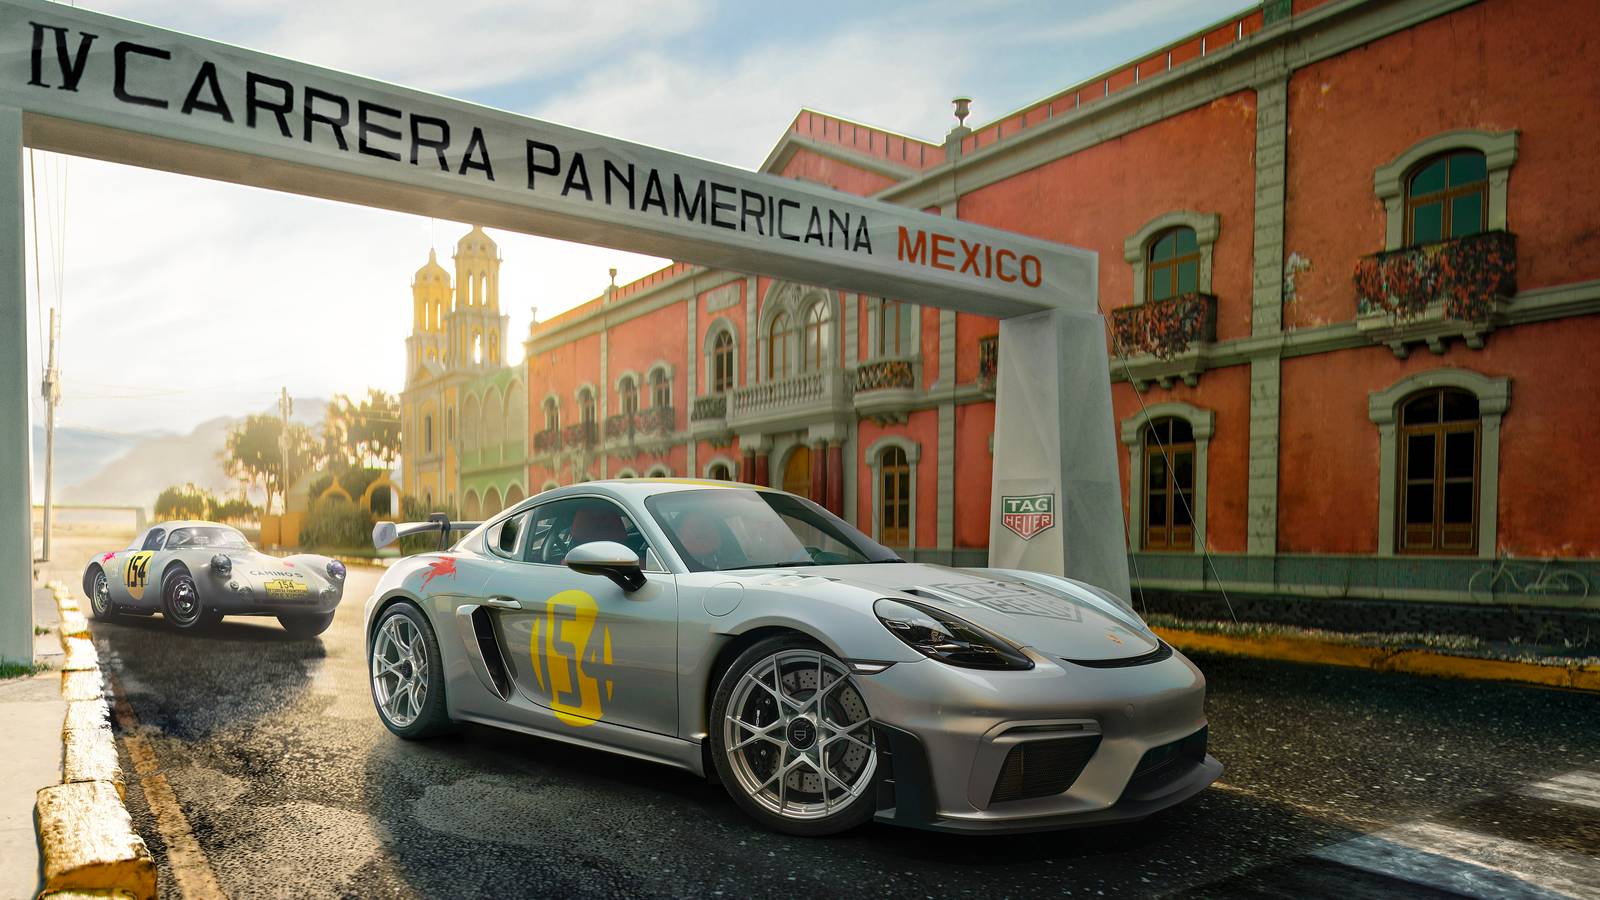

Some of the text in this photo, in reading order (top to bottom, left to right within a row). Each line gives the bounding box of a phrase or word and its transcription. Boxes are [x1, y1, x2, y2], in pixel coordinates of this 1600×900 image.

[27, 21, 1042, 288] IV CARRERA PANAMERICANA MEXICO
[1007, 498, 1048, 512] TAG
[1005, 515, 1050, 536] HEUER
[127, 555, 151, 587] 154
[278, 581, 295, 589] 154
[537, 598, 616, 715] 154
